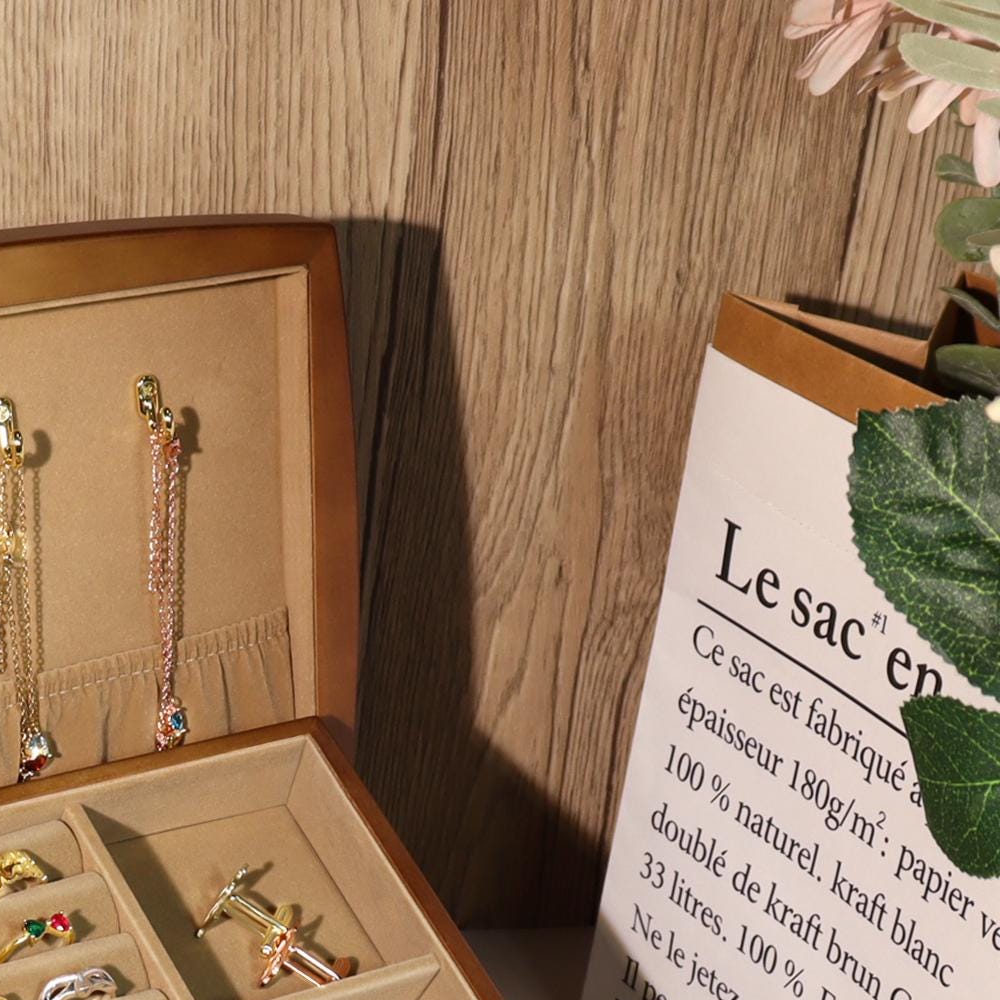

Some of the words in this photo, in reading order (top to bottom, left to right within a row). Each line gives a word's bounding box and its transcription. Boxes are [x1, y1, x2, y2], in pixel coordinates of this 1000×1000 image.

[716, 518, 780, 608] Le
[791, 588, 865, 660] sac
[693, 625, 724, 666] Ce
[729, 656, 765, 693] sac
[770, 683, 802, 719] est
[806, 698, 907, 791] fabriqué
[665, 744, 704, 791] 100
[711, 775, 730, 811] %
[735, 802, 821, 882] naturel.
[830, 861, 887, 931] kraft
[891, 908, 953, 987] blanc
[678, 688, 783, 776] épaisseur
[894, 845, 974, 920] papier
[622, 955, 640, 991] Il
[631, 904, 662, 950] Ne
[667, 931, 685, 968] le
[640, 852, 665, 888] 33
[669, 871, 726, 942] litres.
[737, 925, 777, 974] 100
[784, 960, 804, 997] %
[651, 803, 727, 877] doublé
[732, 864, 760, 903] de
[764, 882, 822, 950] kraft
[826, 928, 880, 1000] brun
